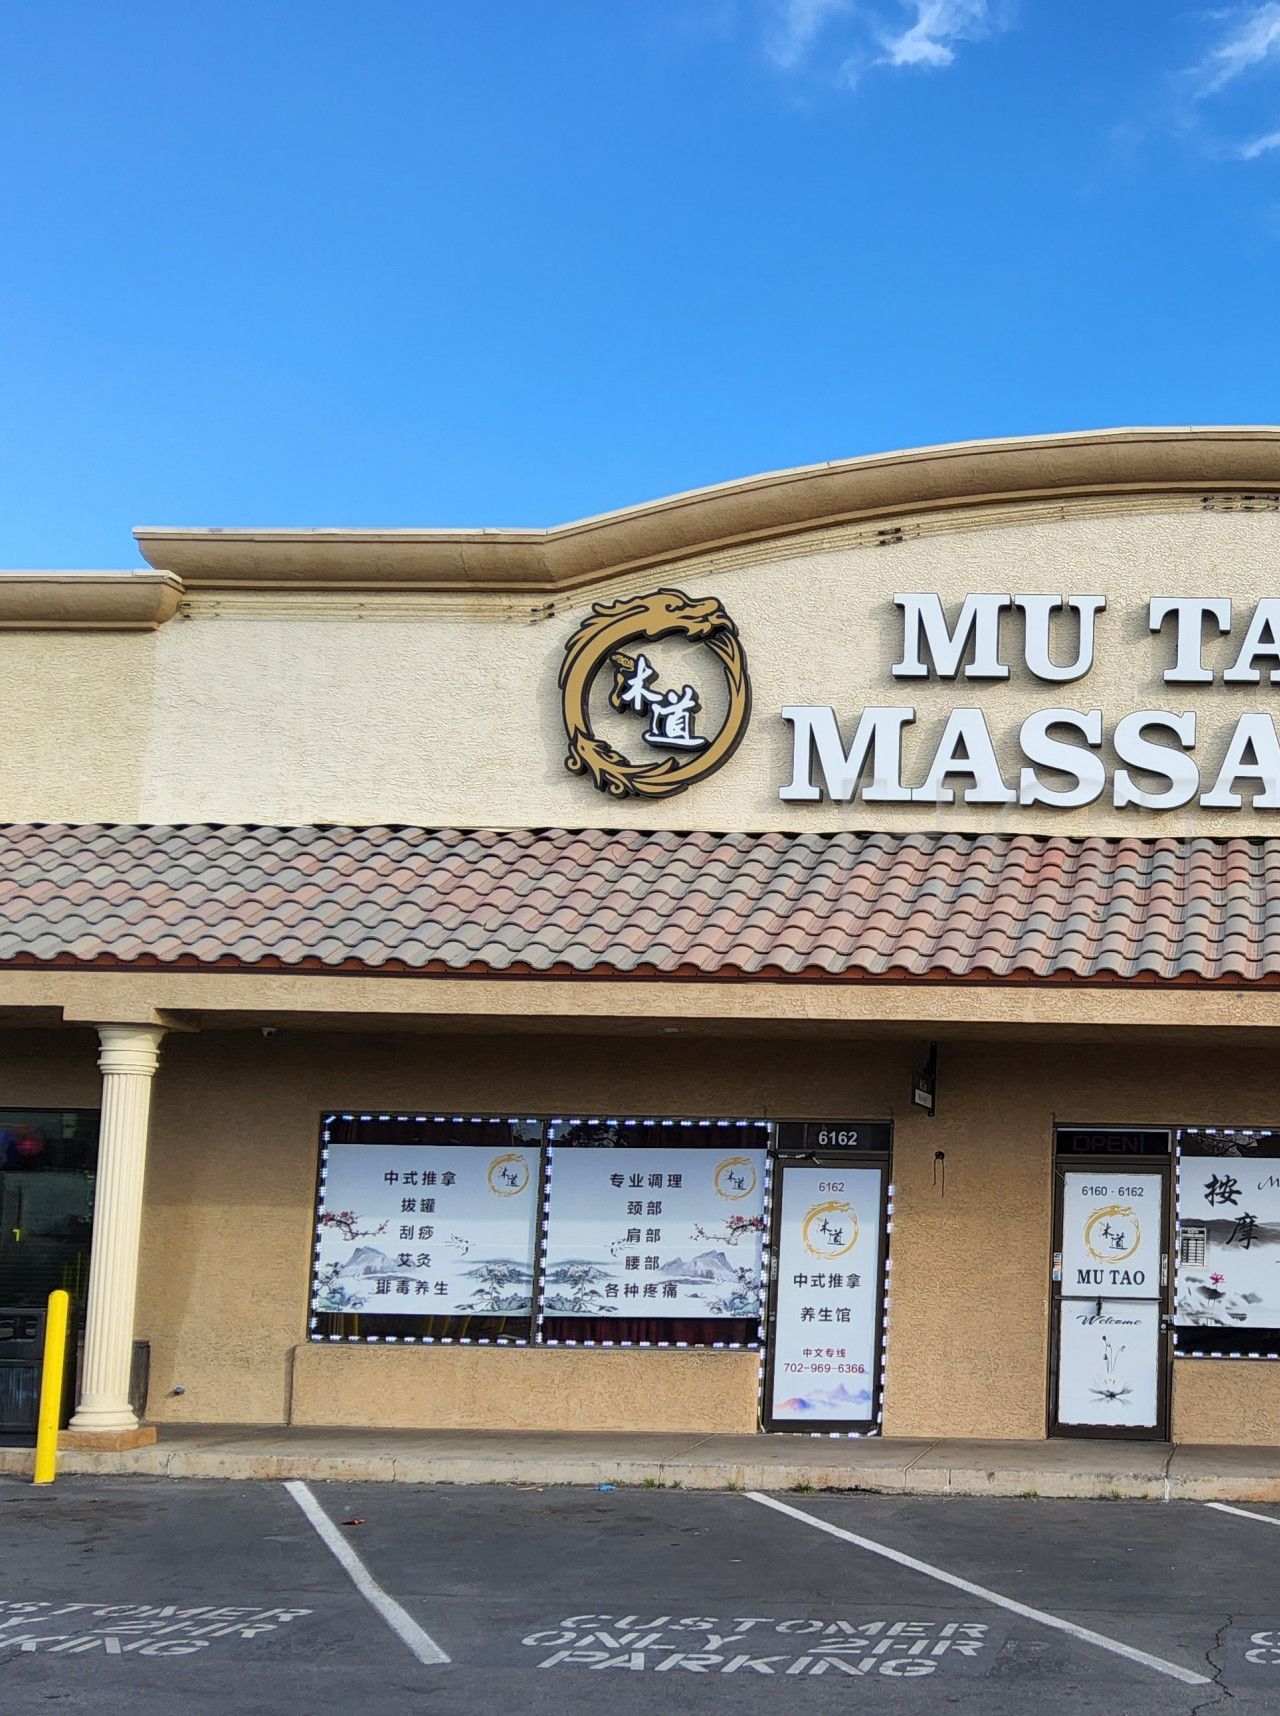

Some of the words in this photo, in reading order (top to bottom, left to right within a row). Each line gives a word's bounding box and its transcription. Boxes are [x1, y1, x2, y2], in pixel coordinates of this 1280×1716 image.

[892, 592, 1106, 683] MU
[818, 1131, 857, 1146] 6162
[384, 1170, 457, 1186] 中式推拿
[609, 1173, 683, 1189] 专业调理
[818, 1182, 845, 1192] 6162
[1082, 1186, 1107, 1196] 6160
[1118, 1187, 1144, 1197] 6162
[401, 1198, 436, 1213] 拔罐
[627, 1201, 663, 1216] 颈部
[400, 1225, 434, 1240] 刮痧
[626, 1228, 661, 1243] 肩部
[397, 1253, 432, 1268] 艾灸
[625, 1256, 660, 1271] 腰部
[793, 1273, 862, 1289] 中式推拿
[1077, 1269, 1103, 1284] MU
[1110, 1270, 1145, 1285] TAO
[376, 1280, 449, 1296] 排毒养生
[605, 1283, 678, 1299] 各种疼痛
[800, 1307, 851, 1323] 养生馆
[1075, 1314, 1142, 1326] Welcome
[802, 1348, 846, 1358] 中文专线
[783, 1363, 865, 1374] 702-969-6366
[0, 1602, 314, 1622] STOMER
[92, 1620, 278, 1638] 2HR
[560, 1614, 989, 1640] CUSTOMER
[521, 1632, 747, 1651] ONLY
[806, 1638, 985, 1657] 2HR
[536, 1650, 937, 1677] PARKING
